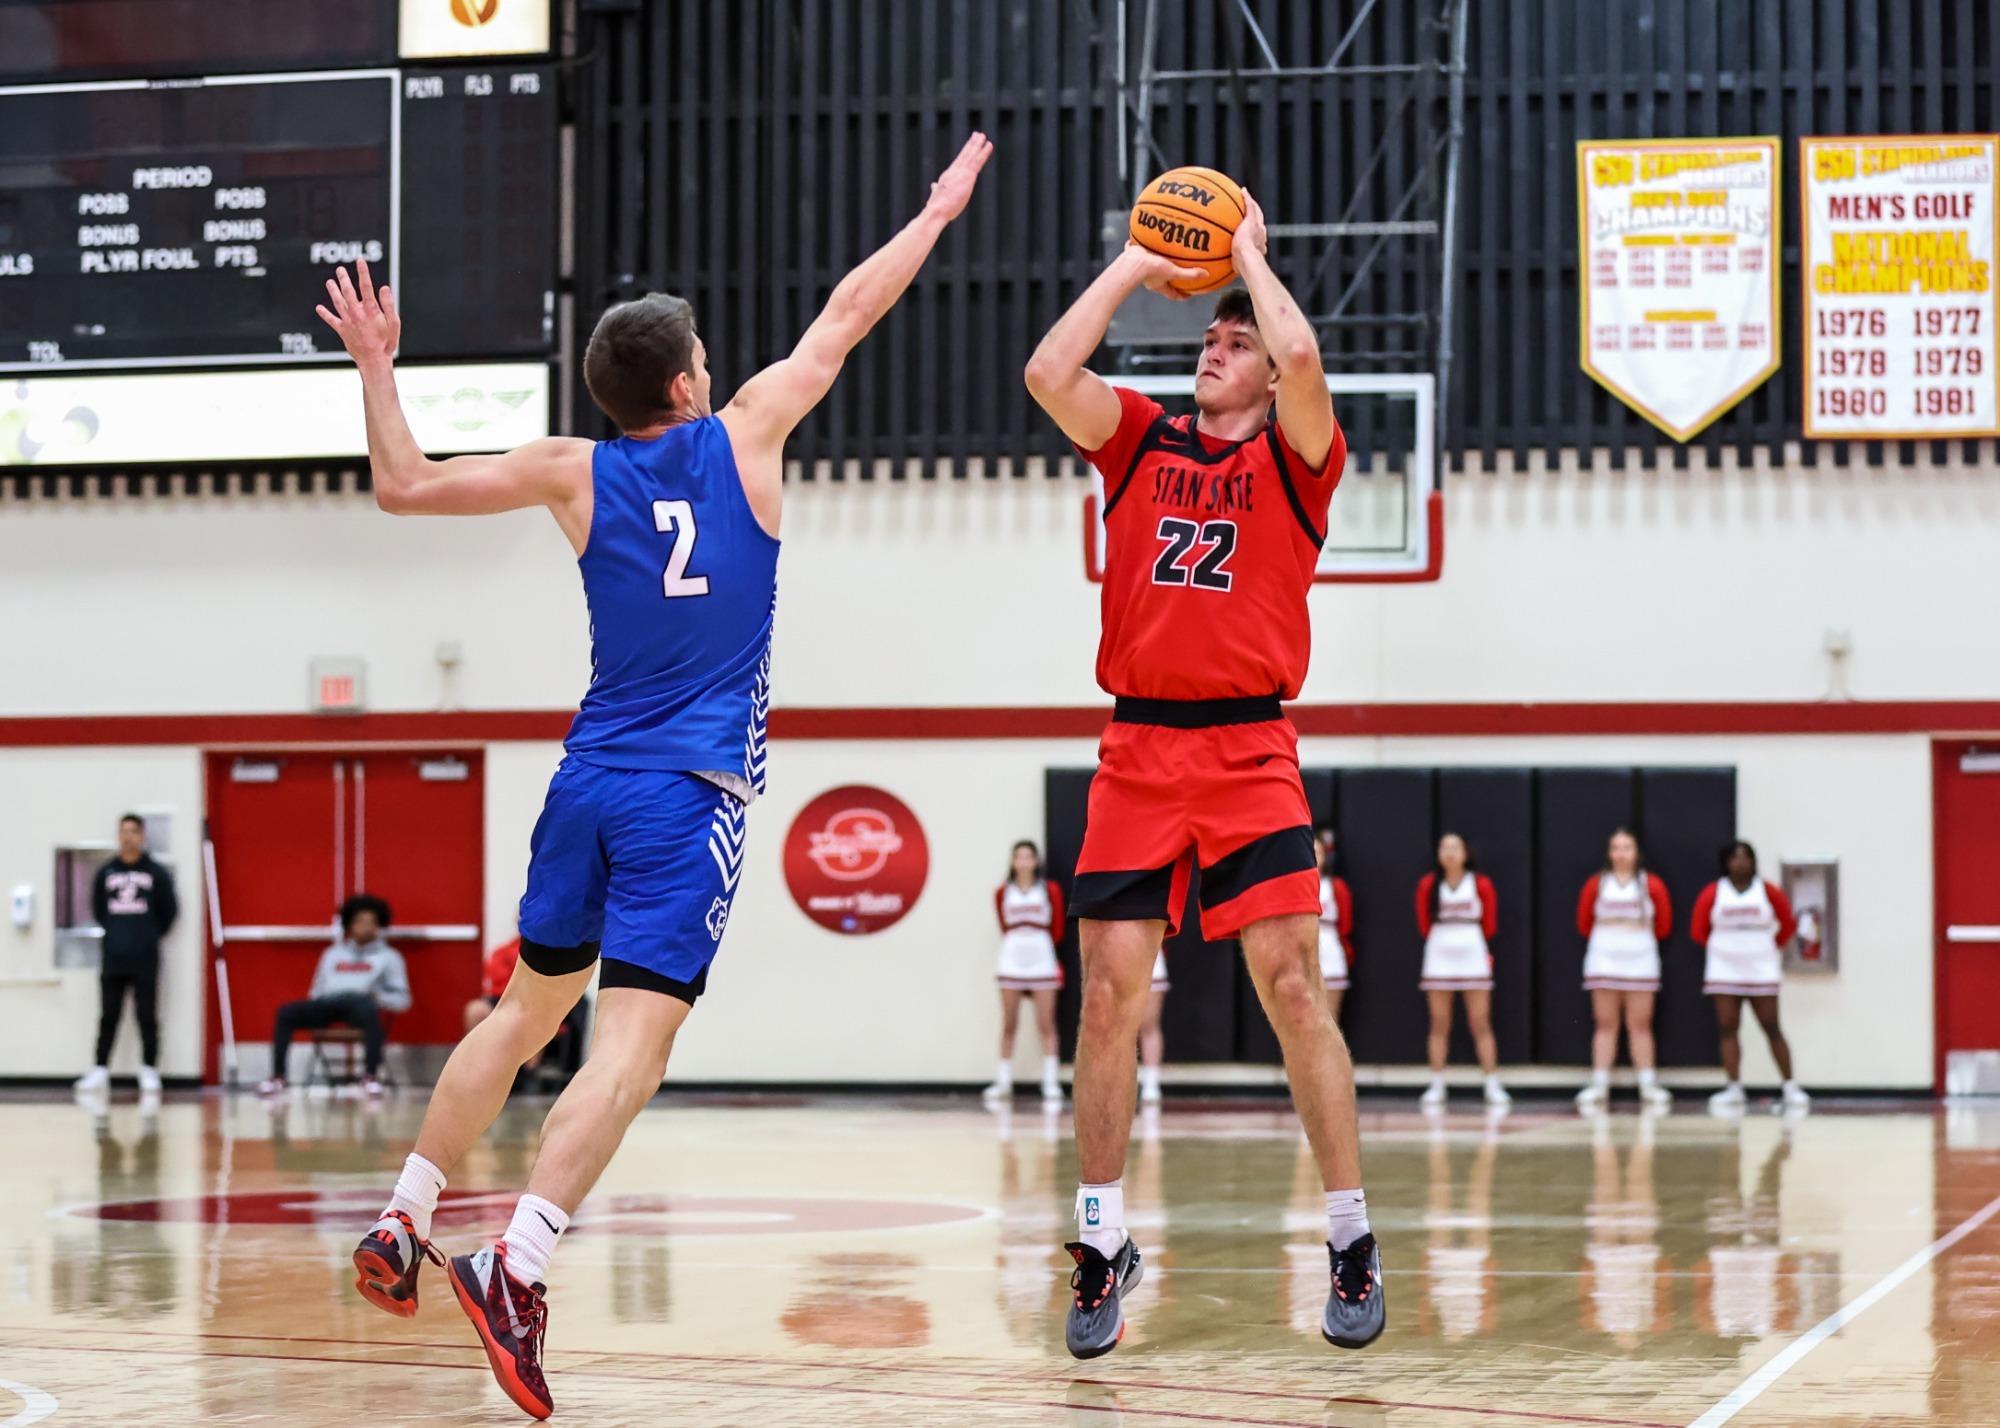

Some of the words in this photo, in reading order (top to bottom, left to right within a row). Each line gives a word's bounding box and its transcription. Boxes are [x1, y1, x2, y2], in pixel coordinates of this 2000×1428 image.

[510, 73, 540, 94] PTS
[133, 166, 213, 189] PERIOD
[78, 193, 129, 215] POSS
[214, 187, 267, 209] POSS
[1157, 181, 1215, 207] NCAA
[1829, 193, 1906, 220] MEN'S
[1913, 192, 1975, 220] GOLF
[78, 224, 140, 247] BONUS
[203, 219, 267, 242] BONUS
[1137, 209, 1210, 252] Wilson
[81, 250, 140, 273] PLYR
[142, 249, 199, 270] FOUL
[214, 246, 258, 267] PTS
[310, 240, 383, 264] FOULS
[1832, 230, 1972, 266] NATIONAL
[1815, 260, 1989, 296] CHAMPIONS
[1818, 308, 1886, 337] 1976
[1913, 307, 1981, 337] 1977
[1818, 348, 1887, 377] 1978
[1914, 347, 1982, 376] 1979
[1818, 387, 1887, 416] 1980
[1914, 387, 1975, 416] 1981
[1152, 466, 1205, 509] STAN
[651, 498, 711, 598] 2
[1152, 516, 1238, 593] 22
